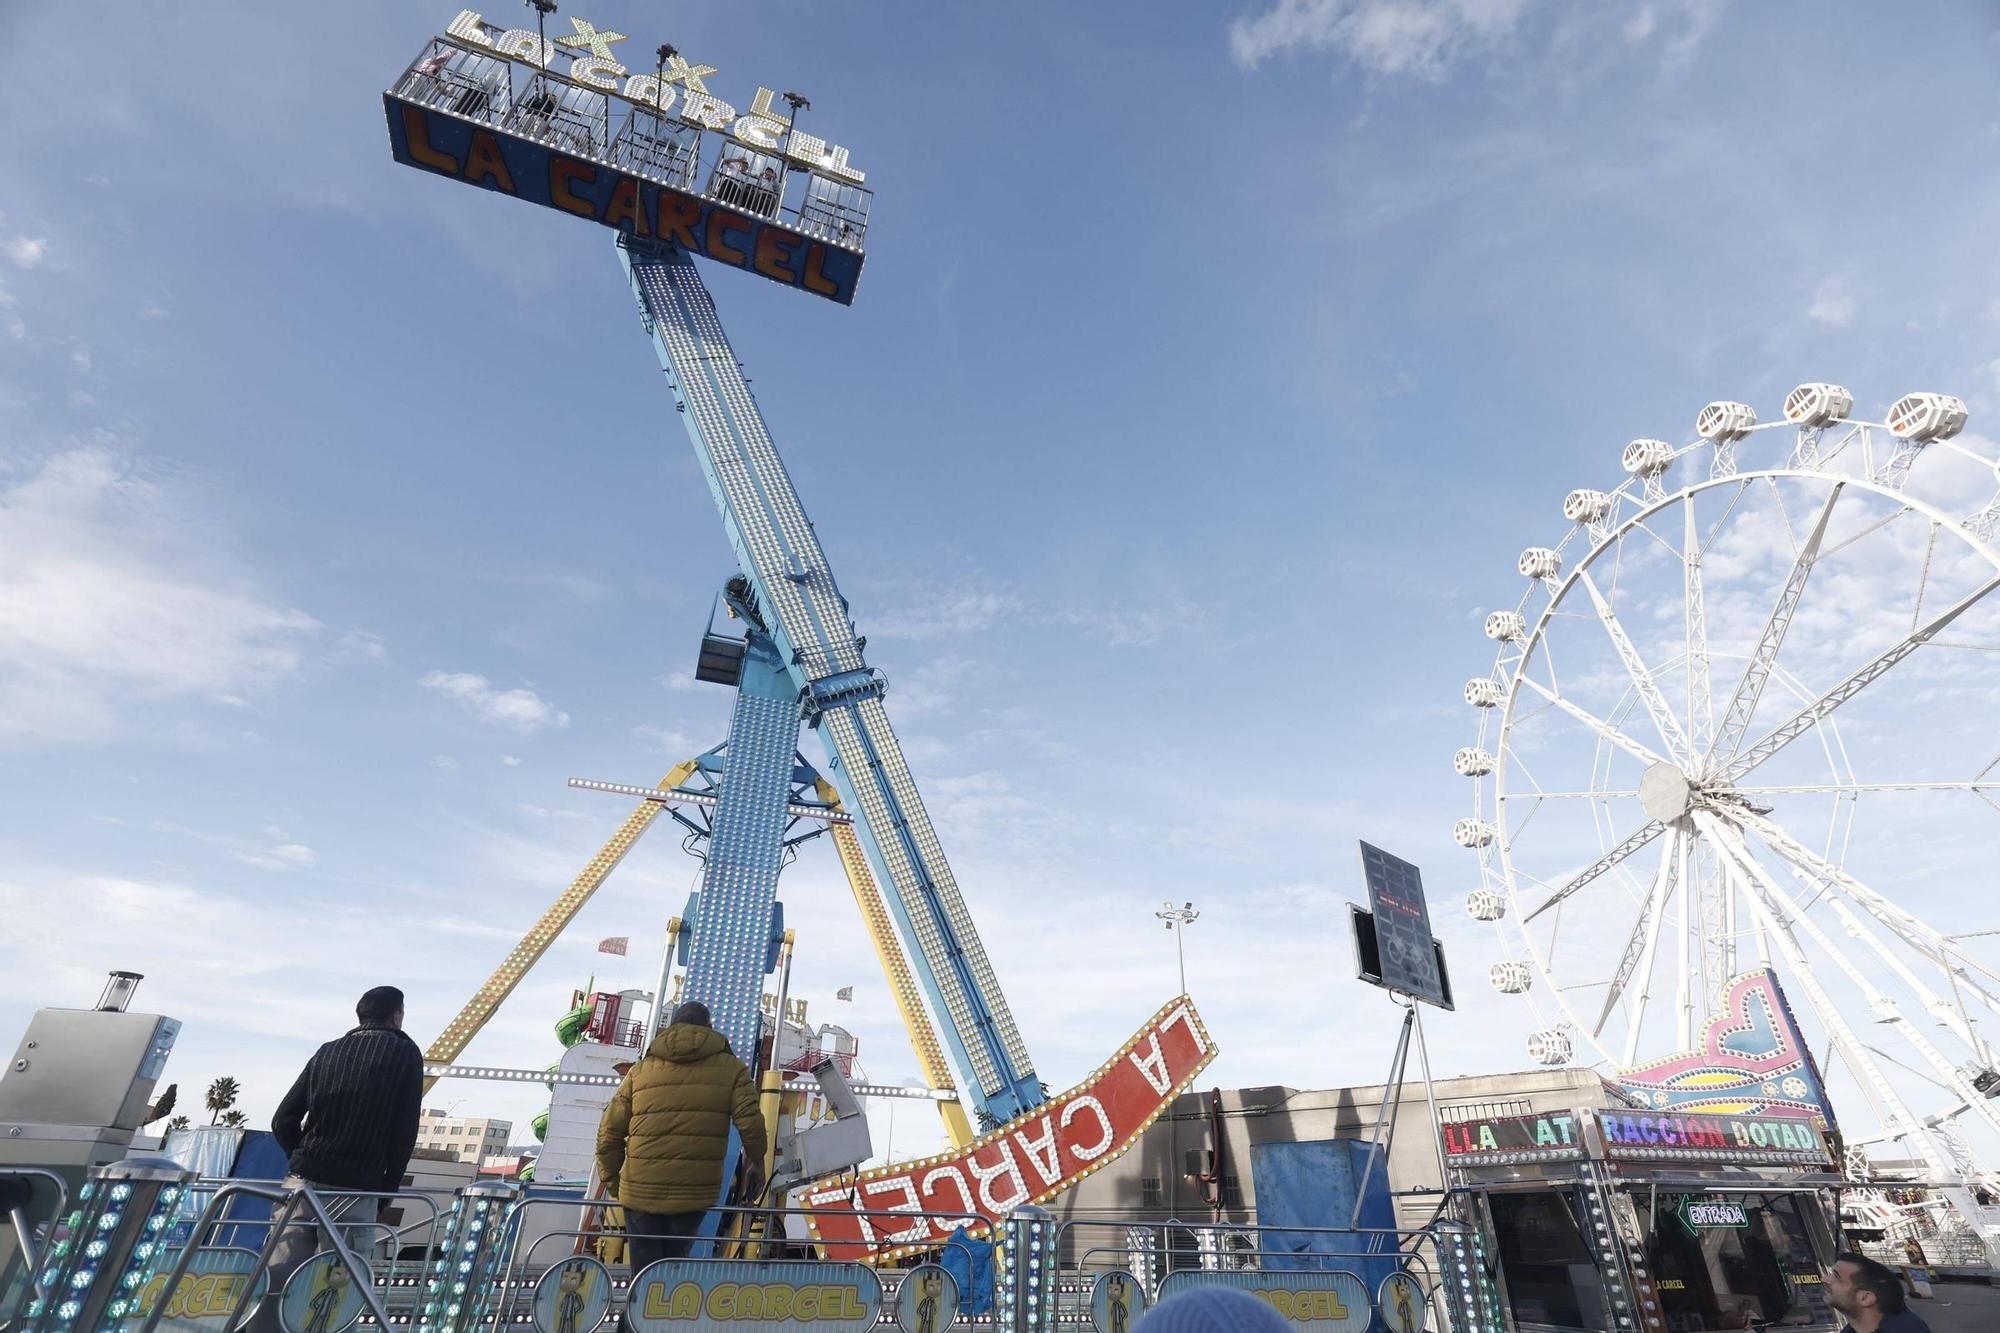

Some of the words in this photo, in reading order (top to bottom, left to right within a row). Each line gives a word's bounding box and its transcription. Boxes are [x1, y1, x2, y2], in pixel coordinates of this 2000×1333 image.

[445, 9, 555, 70] LA
[571, 56, 865, 184] CARCEL
[404, 107, 516, 193] LA
[549, 155, 839, 297] CARCEL
[1129, 1001, 1208, 1097] LA
[810, 1095, 1115, 1252] CARCEL
[1689, 1206, 1745, 1224] ENTRADA
[645, 1283, 702, 1319] LA
[706, 1284, 867, 1321] CARCEL
